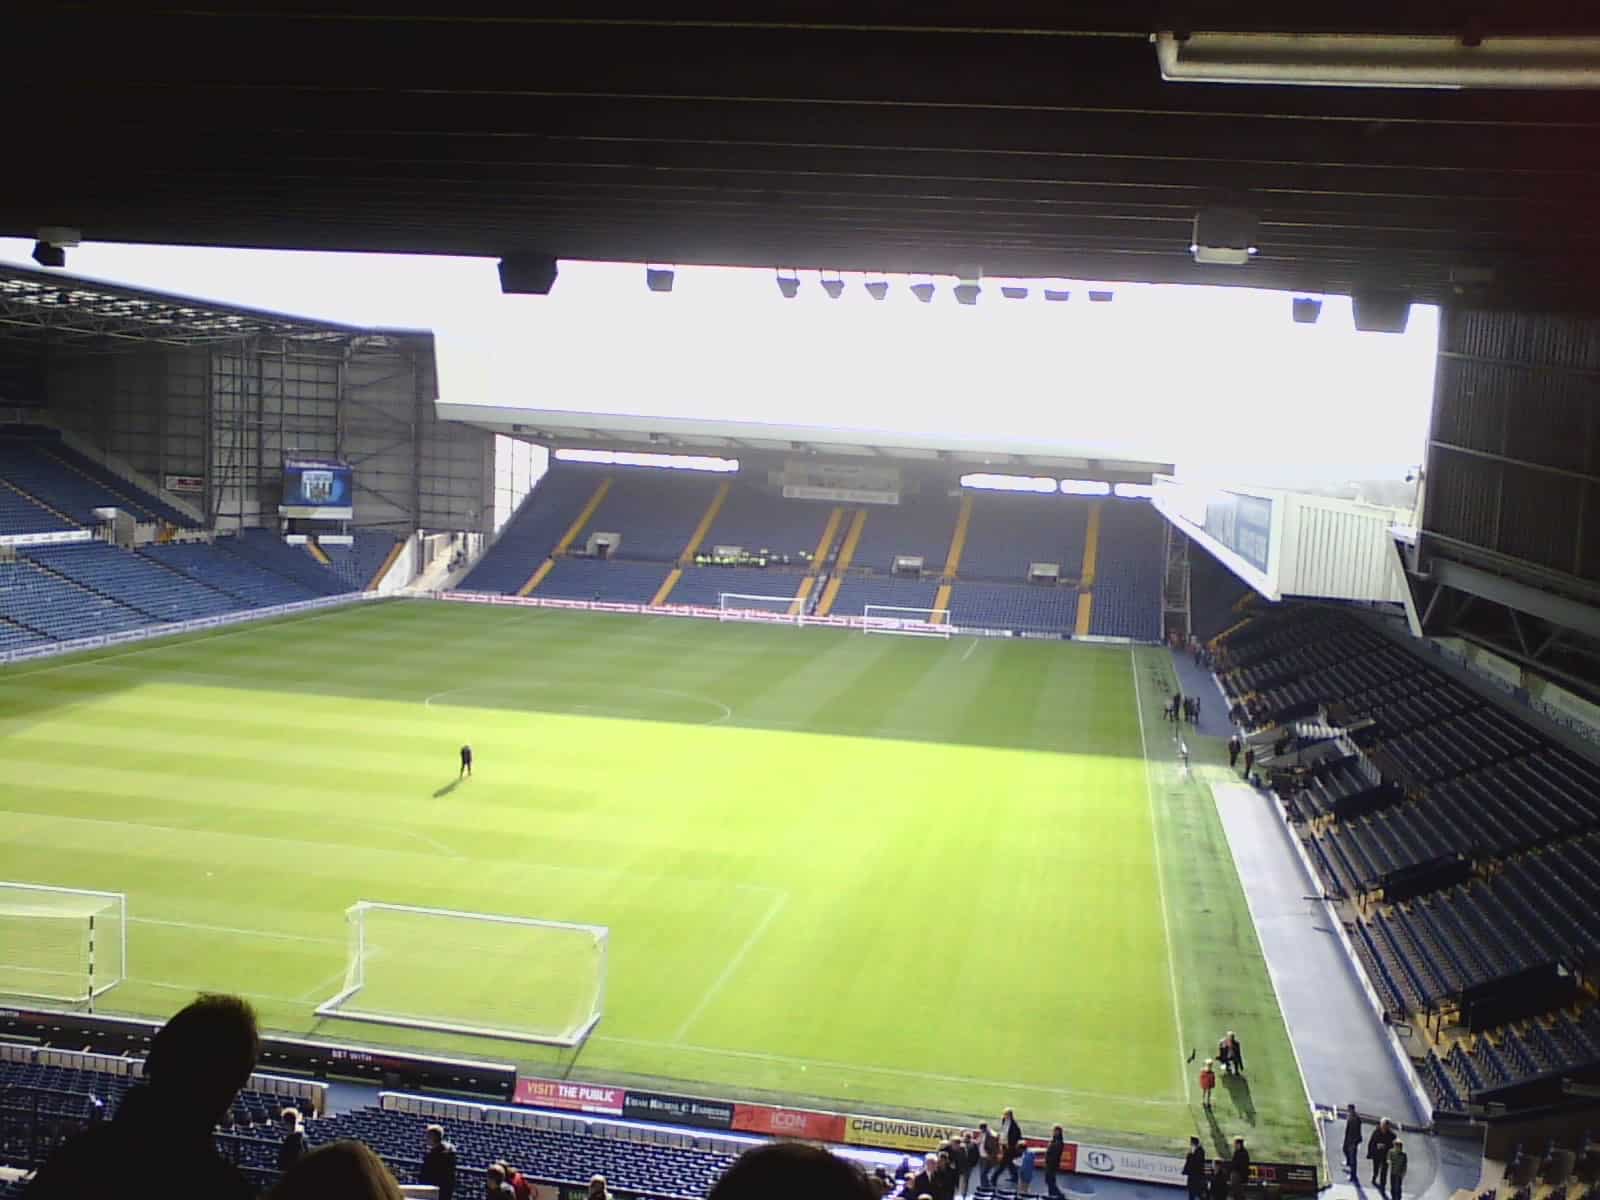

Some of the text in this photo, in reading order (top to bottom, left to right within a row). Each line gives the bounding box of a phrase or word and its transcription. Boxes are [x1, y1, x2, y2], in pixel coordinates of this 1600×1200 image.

[527, 1081, 615, 1103] VISIT THE PUBLIC
[852, 1118, 953, 1140] CROWNSWAY
